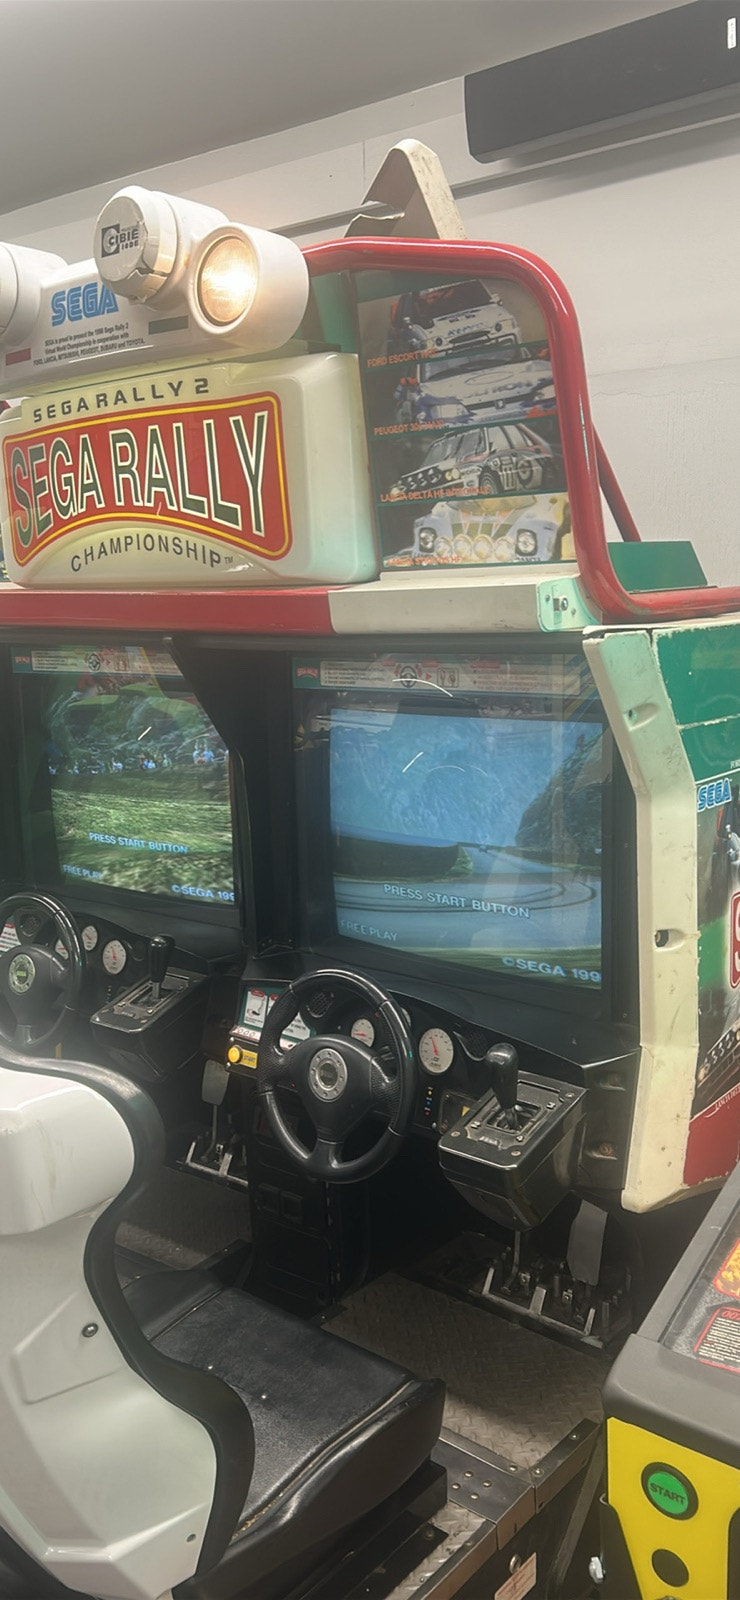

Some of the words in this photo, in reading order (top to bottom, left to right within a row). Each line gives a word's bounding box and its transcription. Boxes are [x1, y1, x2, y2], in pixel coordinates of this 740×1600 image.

[52, 282, 118, 326] SEGA
[367, 356, 388, 368] FORD
[388, 352, 419, 364] ESCORT
[194, 378, 209, 394] 2
[374, 423, 409, 436] PEUGEOT
[11, 434, 105, 547] SEGA
[109, 411, 268, 537] RALLY
[71, 533, 221, 572] CHAMPIONSHIP
[698, 778, 731, 812] SEGA
[89, 832, 116, 845] PRESS
[118, 836, 146, 849] START
[148, 841, 188, 854] BUTTON
[63, 864, 82, 877] FREE
[384, 883, 423, 901] PRESS
[427, 891, 466, 909] START
[472, 899, 530, 919] BUTTON
[340, 919, 367, 936] FREE
[369, 925, 398, 942] PLAY
[650, 1482, 688, 1506] START
